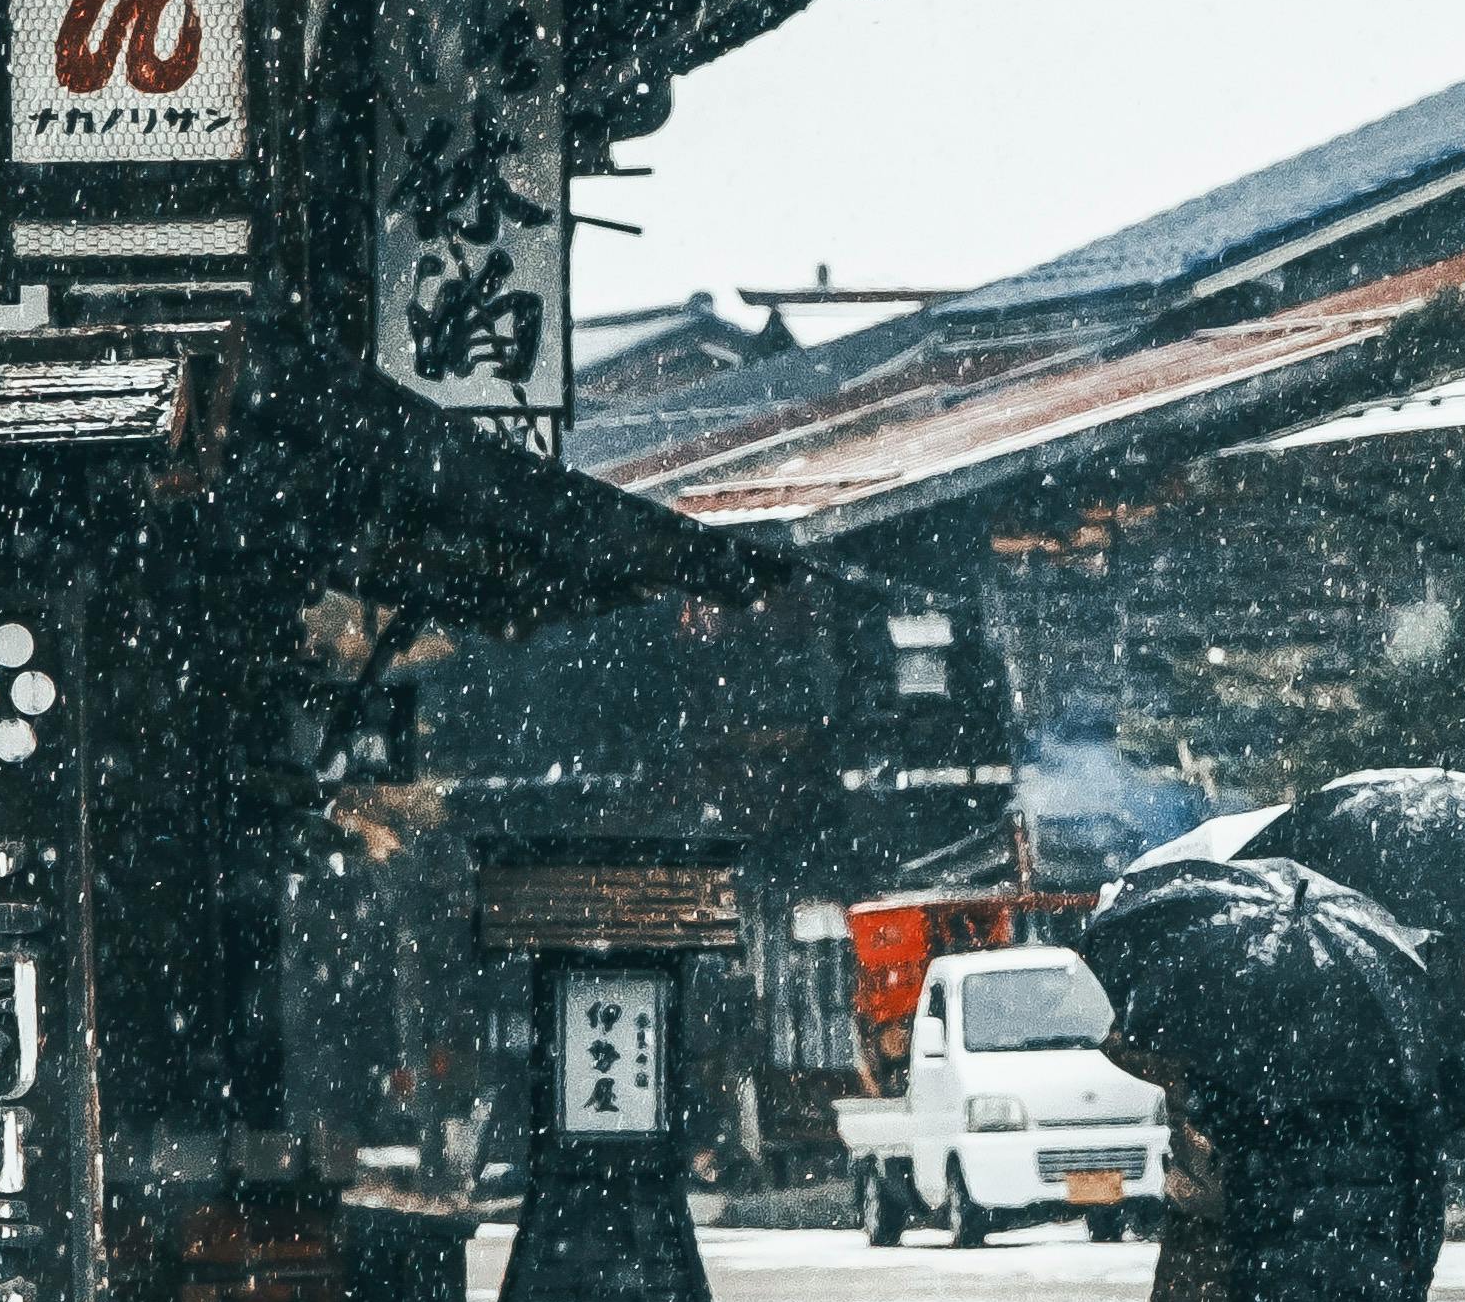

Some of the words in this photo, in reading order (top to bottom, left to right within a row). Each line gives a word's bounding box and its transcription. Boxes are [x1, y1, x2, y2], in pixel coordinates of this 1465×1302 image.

[28, 106, 231, 135] ナカノリサン
